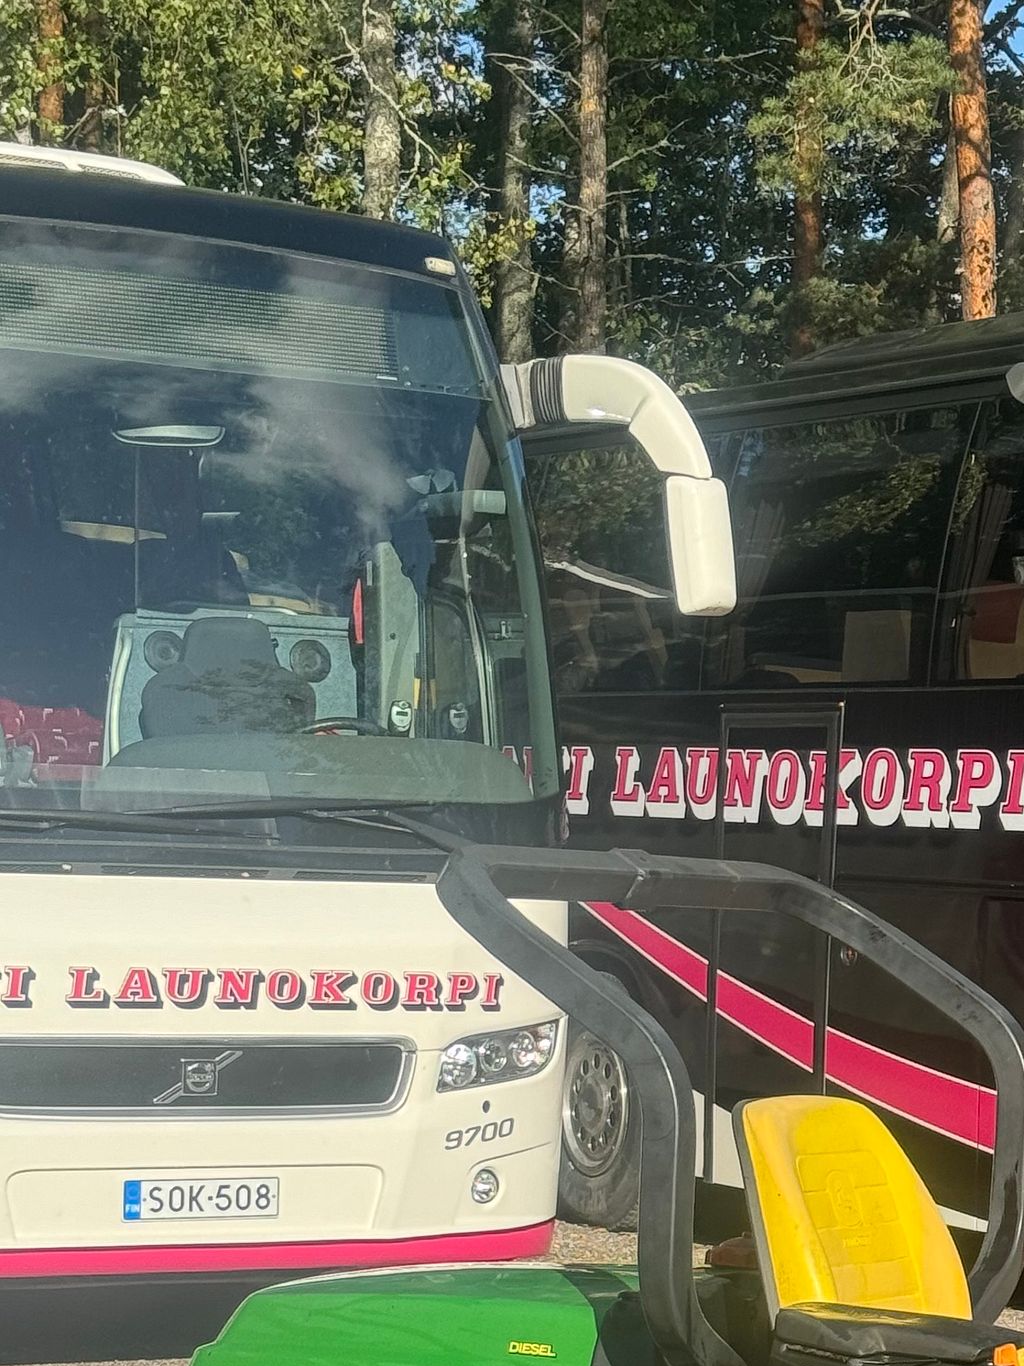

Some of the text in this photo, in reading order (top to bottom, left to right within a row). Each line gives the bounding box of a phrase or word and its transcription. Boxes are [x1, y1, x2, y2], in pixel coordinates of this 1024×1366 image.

[0, 965, 504, 1012] I LAUNOKORPI
[444, 1117, 515, 1150] 9700
[125, 1204, 140, 1214] FIN
[149, 1184, 271, 1212] SOK-508
[509, 1341, 557, 1358] DIESEL
